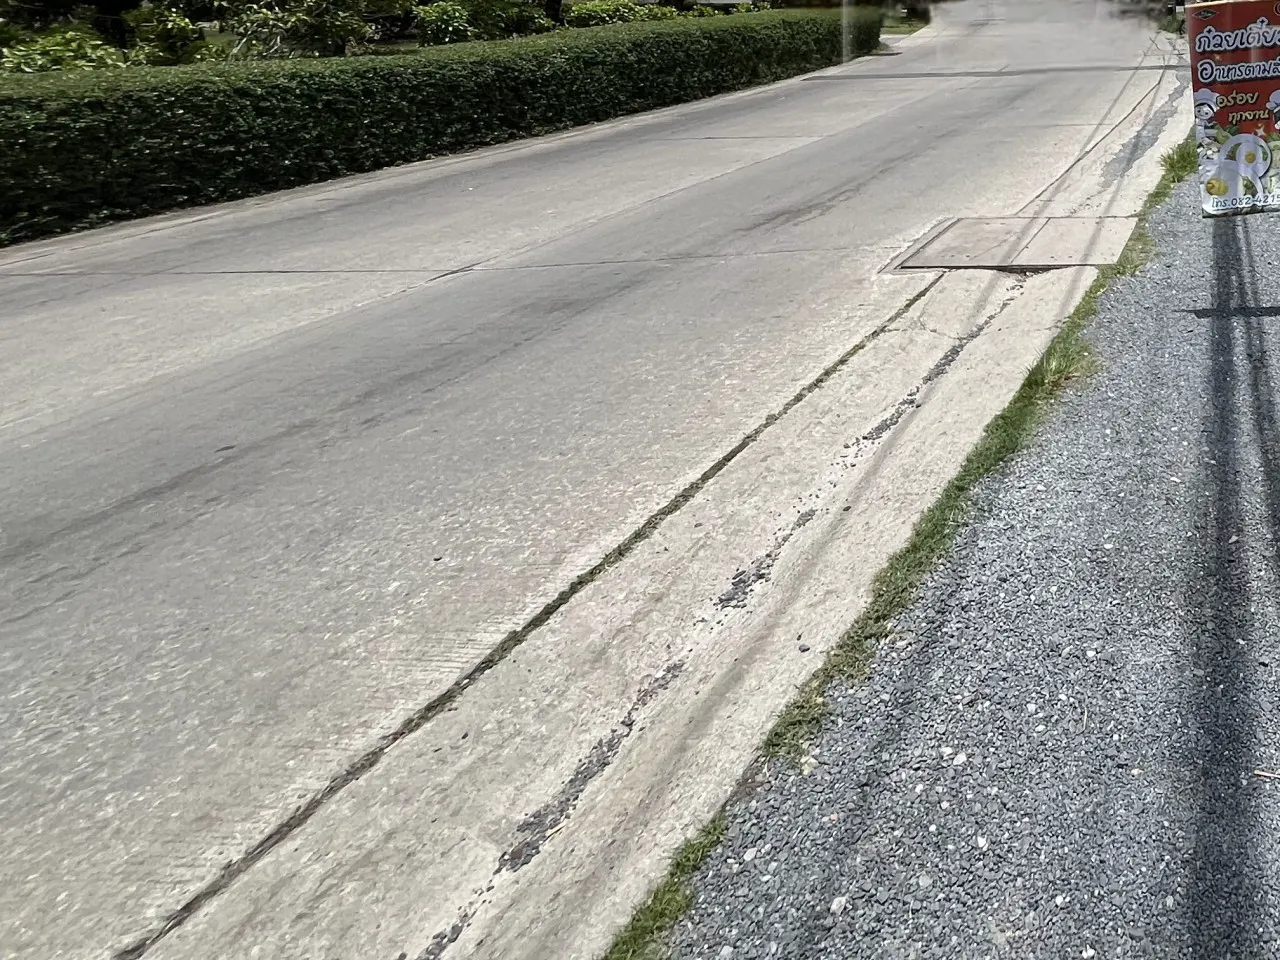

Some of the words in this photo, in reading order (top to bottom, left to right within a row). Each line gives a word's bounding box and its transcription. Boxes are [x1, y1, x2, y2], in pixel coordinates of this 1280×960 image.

[1216, 89, 1259, 107] อร่อย
[1228, 108, 1270, 125] ทุกจาน
